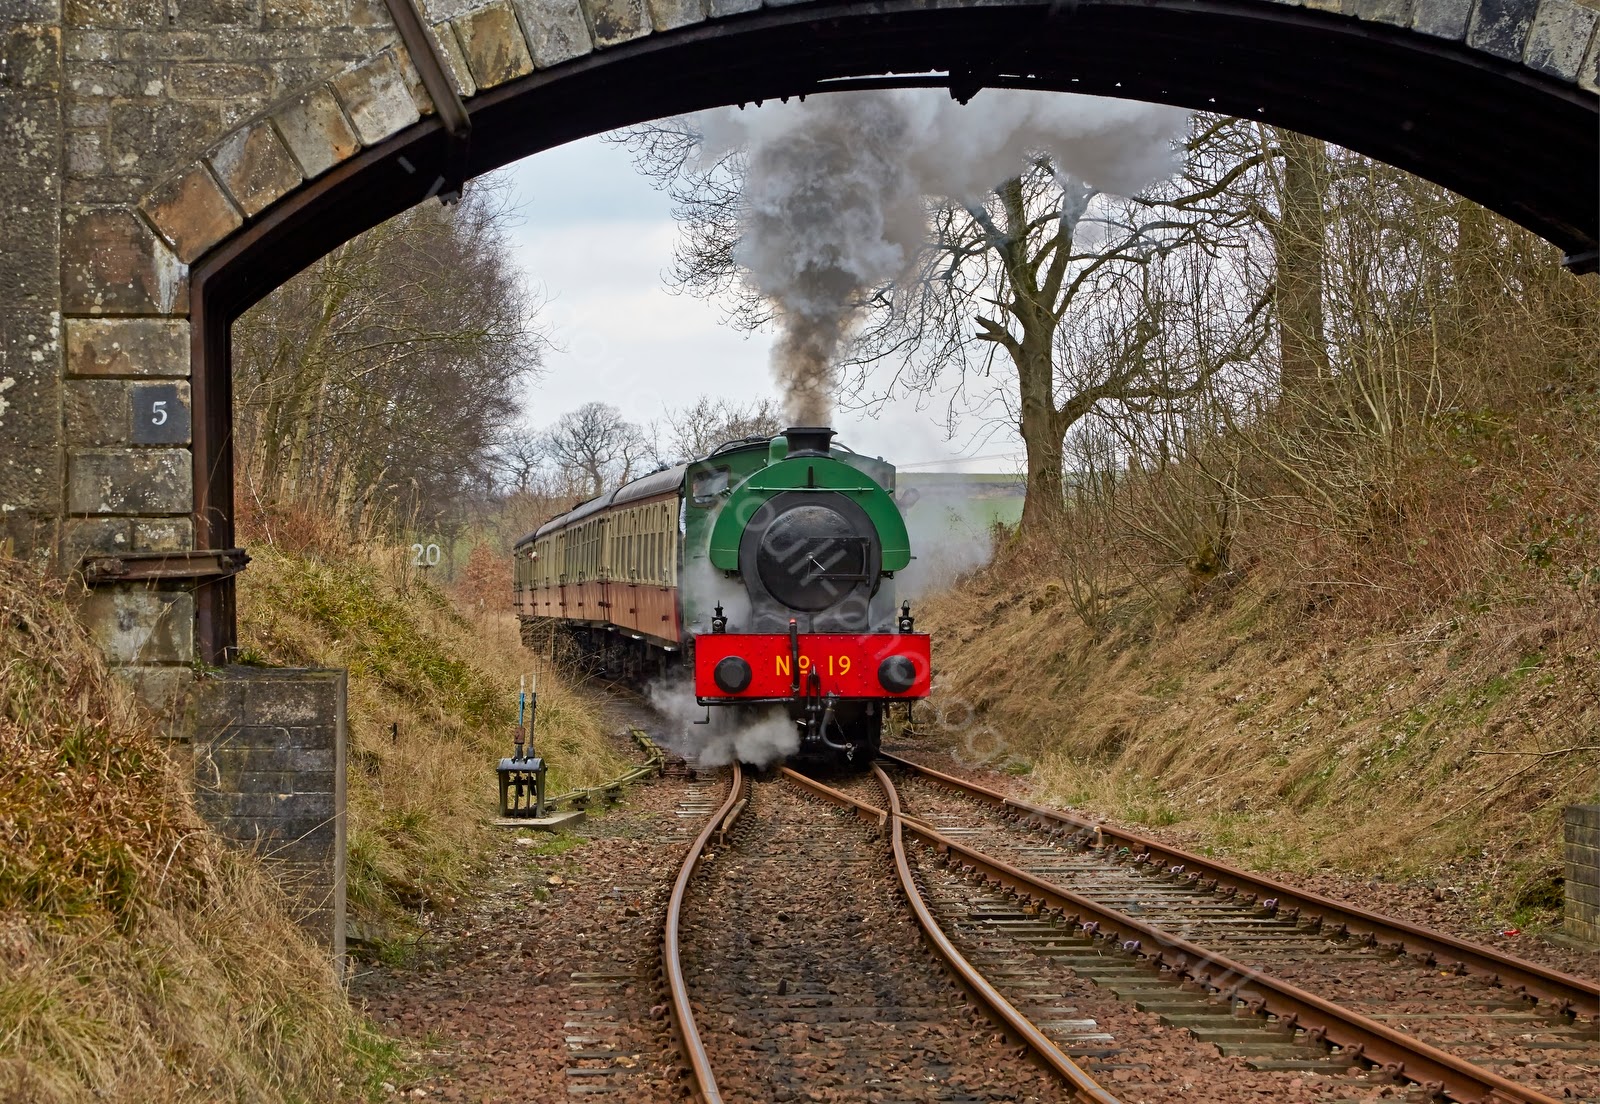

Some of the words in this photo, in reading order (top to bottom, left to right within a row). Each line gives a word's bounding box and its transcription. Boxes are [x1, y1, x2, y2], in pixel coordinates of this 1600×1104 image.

[152, 401, 168, 426] 5
[411, 543, 441, 566] 20
[828, 655, 851, 676] 19
